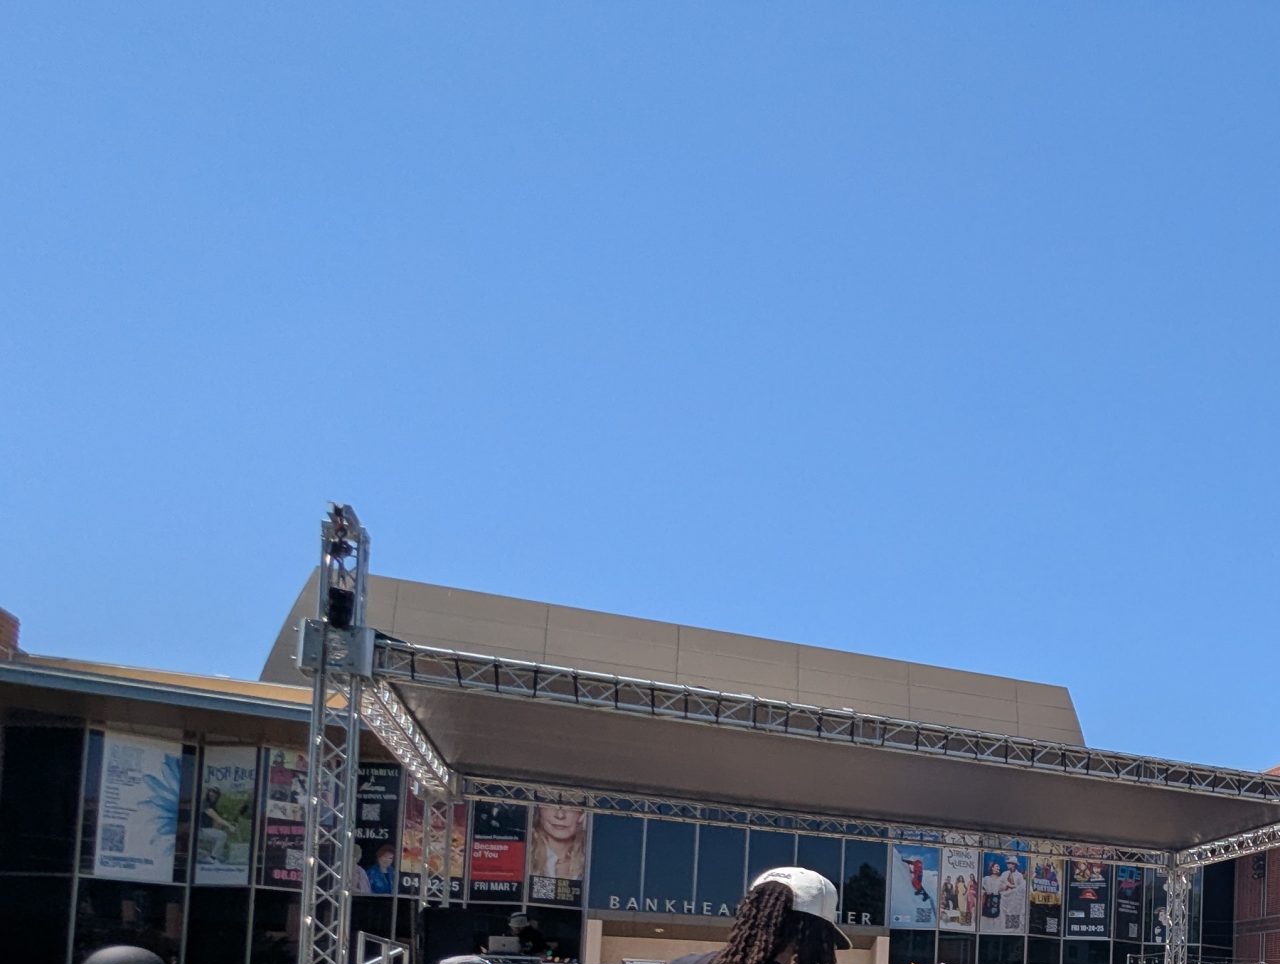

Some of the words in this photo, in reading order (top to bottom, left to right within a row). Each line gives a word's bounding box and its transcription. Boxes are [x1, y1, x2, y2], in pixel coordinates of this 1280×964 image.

[474, 842, 509, 851] Because
[473, 850, 482, 858] of
[484, 850, 499, 858] You
[474, 881, 488, 891] FRI
[490, 882, 510, 892] MAR
[511, 883, 518, 892] 7
